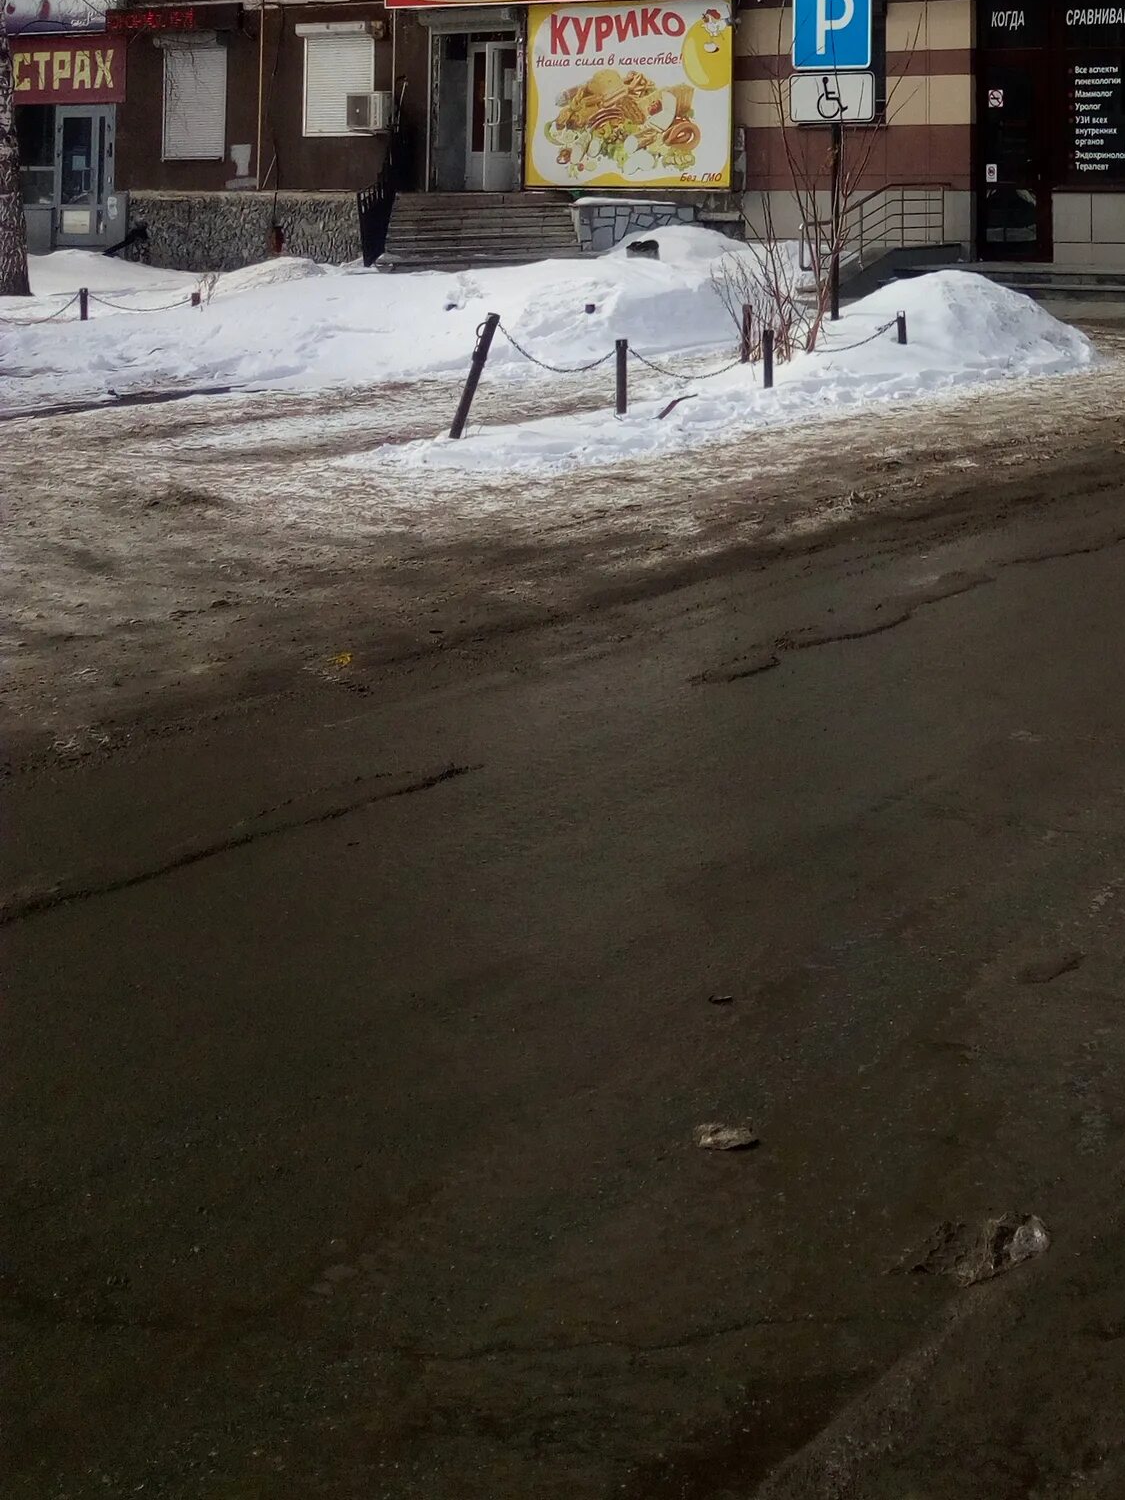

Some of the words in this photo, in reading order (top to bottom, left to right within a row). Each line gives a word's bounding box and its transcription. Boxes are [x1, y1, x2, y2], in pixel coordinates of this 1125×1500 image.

[991, 10, 1025, 30] КОГДА
[550, 8, 686, 55] КУРИКО
[536, 55, 570, 68] Наша
[575, 58, 604, 67] сила
[607, 54, 615, 66] в
[618, 52, 683, 66] качестве!
[13, 49, 115, 91] СТРАХ
[1074, 65, 1088, 74] Все
[1088, 66, 1118, 74] аспекты
[1074, 77, 1121, 86] гинекологии
[1074, 89, 1113, 98] Маммолог
[1074, 102, 1101, 112] Уролог
[1075, 115, 1090, 124] УЗИ
[1092, 116, 1108, 124] всех
[1075, 127, 1118, 136] внутренних
[1075, 138, 1105, 147] органов
[1074, 161, 1109, 172] Терапевт
[680, 172, 697, 182] Без
[701, 172, 723, 183] ГМО
